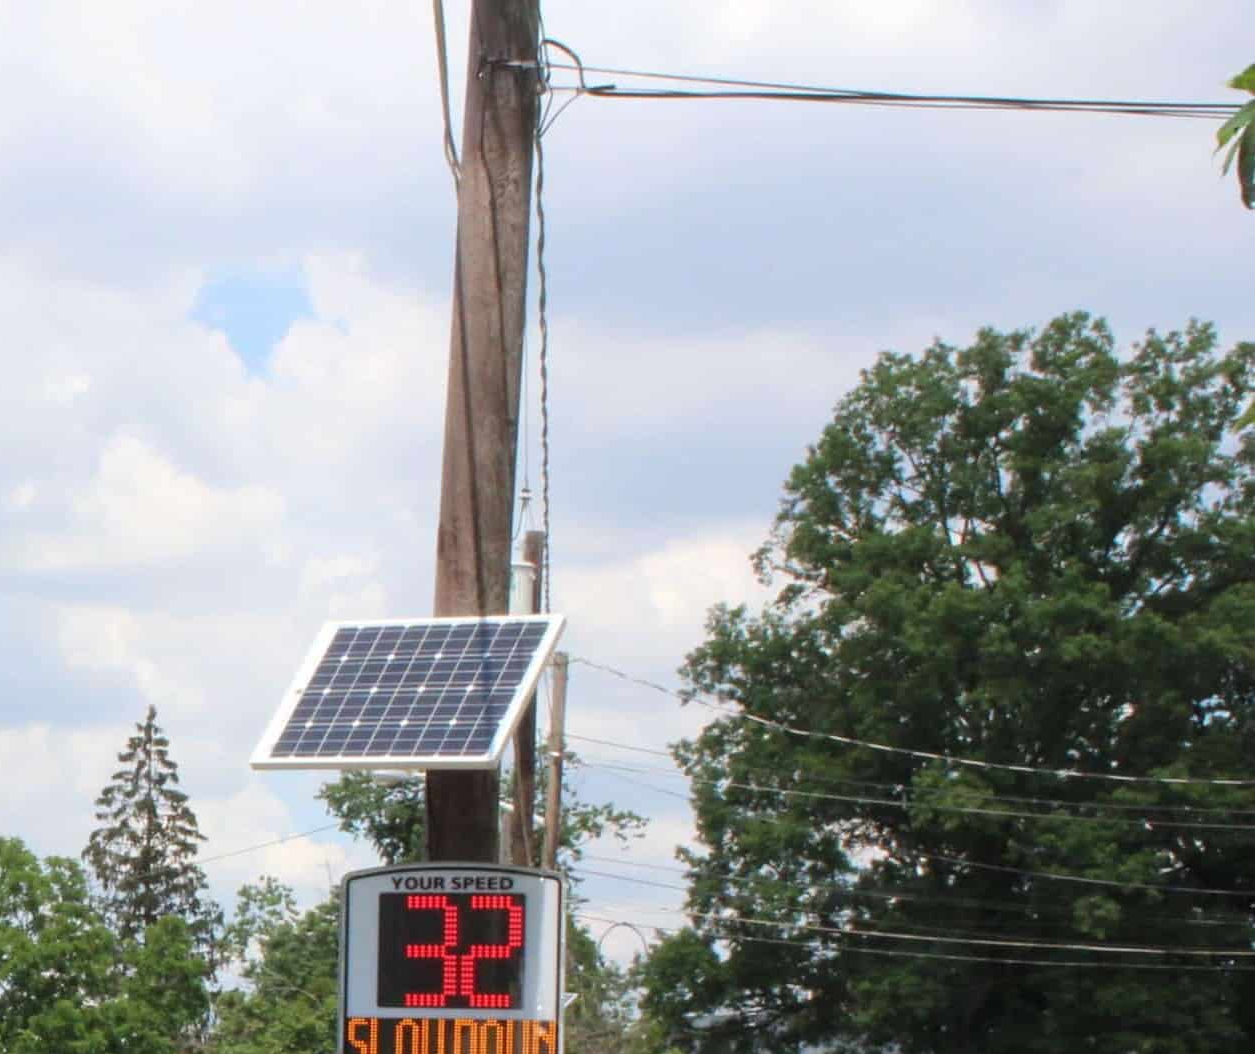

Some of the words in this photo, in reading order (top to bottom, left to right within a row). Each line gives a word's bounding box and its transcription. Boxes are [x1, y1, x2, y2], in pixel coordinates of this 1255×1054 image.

[392, 876, 444, 890] YOUR
[449, 876, 514, 890] SPEED
[404, 894, 523, 1008] 32
